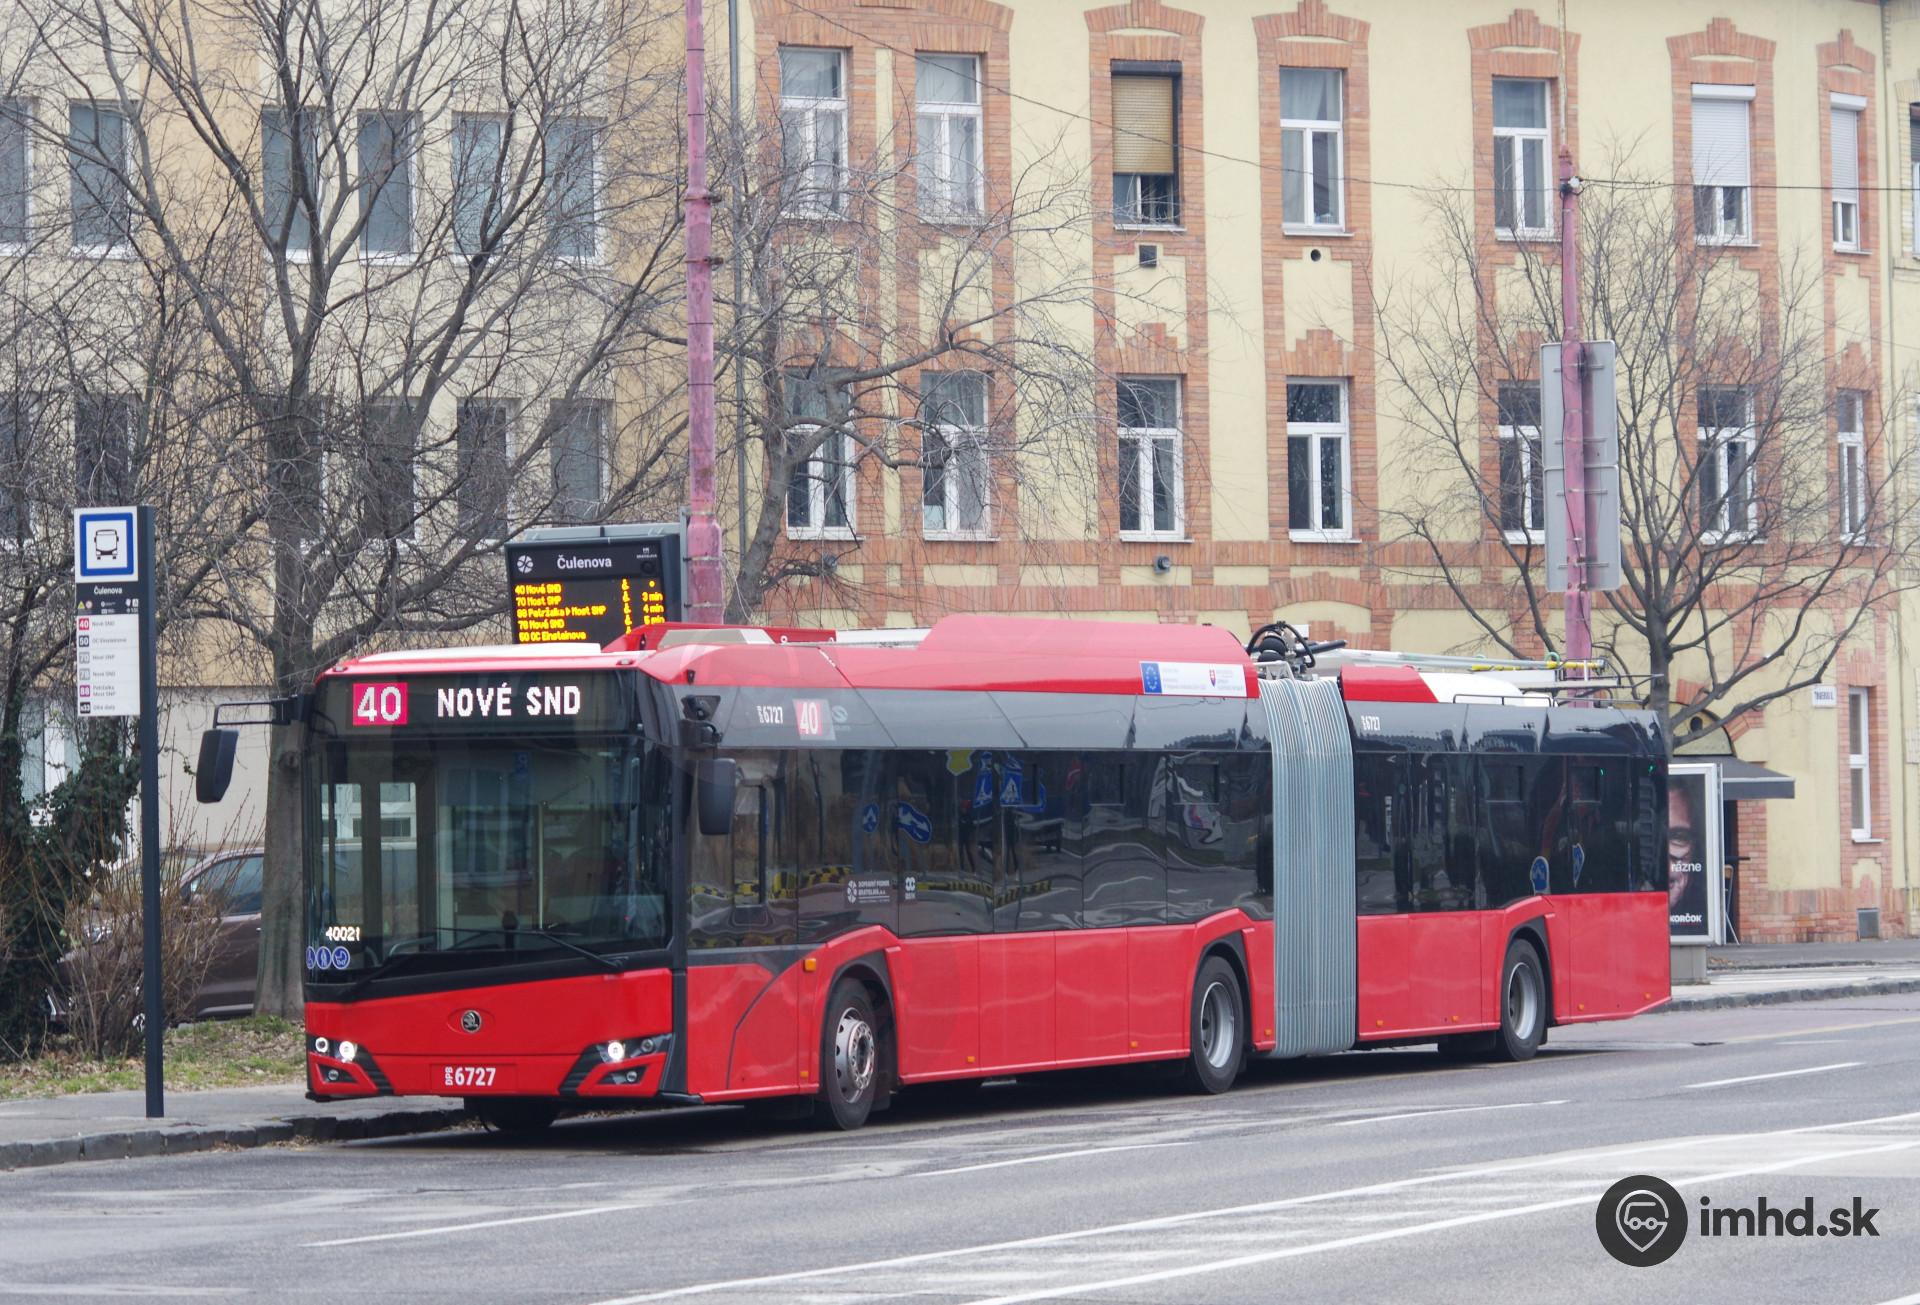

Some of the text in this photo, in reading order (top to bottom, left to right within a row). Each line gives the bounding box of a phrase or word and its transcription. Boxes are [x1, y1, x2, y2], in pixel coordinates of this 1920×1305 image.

[557, 554, 612, 570] Čulenova
[93, 585, 123, 595] Čulenova
[514, 585, 525, 595] 40
[525, 583, 546, 595] Nové
[516, 597, 526, 606] 70
[527, 596, 547, 606] Most
[641, 591, 649, 602] 3
[648, 591, 664, 602] min
[571, 605, 591, 616] Most
[642, 603, 649, 613] 4
[649, 603, 665, 613] min
[80, 620, 89, 629] 40
[80, 637, 89, 646] 50
[357, 682, 581, 722] 40 NOVÉ SND
[763, 705, 784, 724] 6727
[800, 702, 819, 735] 40
[325, 926, 361, 942] 40021
[445, 1066, 496, 1087] DPB 6727
